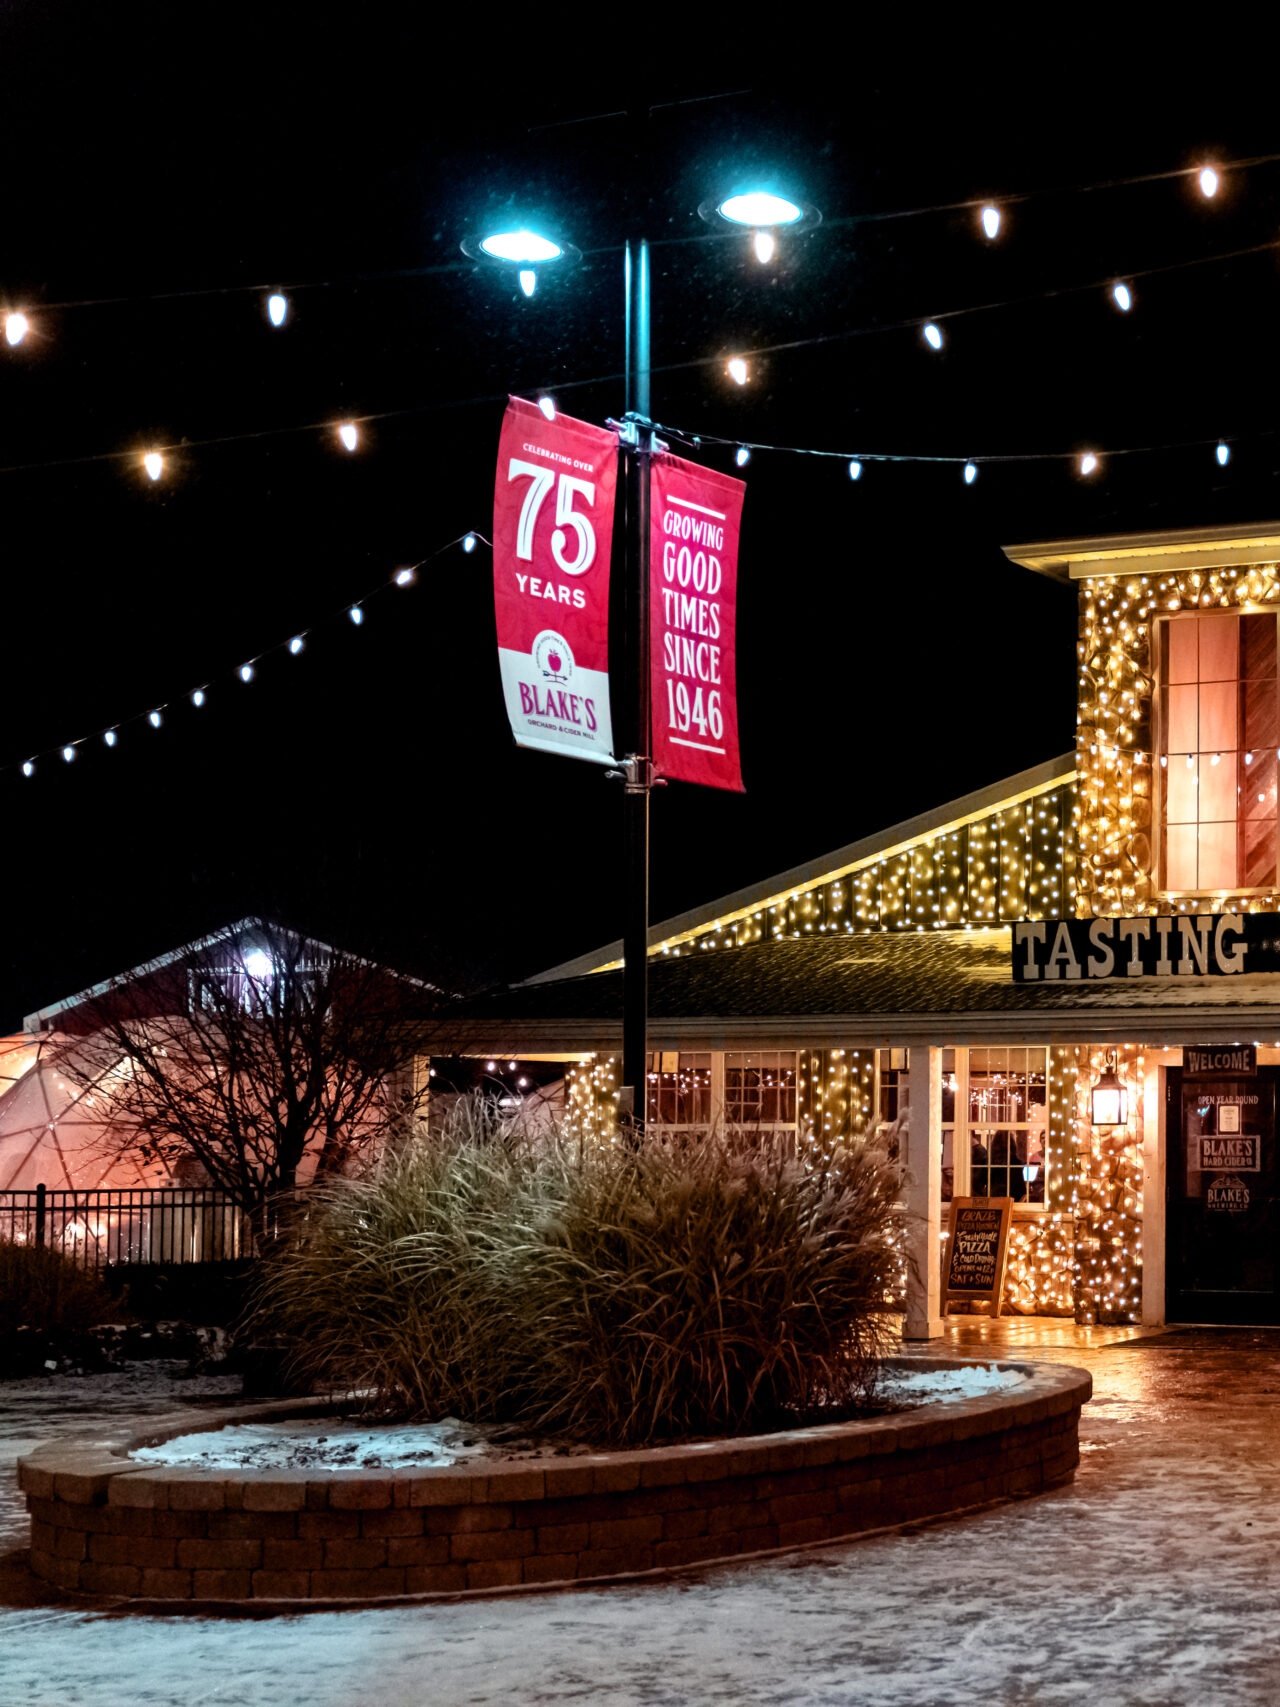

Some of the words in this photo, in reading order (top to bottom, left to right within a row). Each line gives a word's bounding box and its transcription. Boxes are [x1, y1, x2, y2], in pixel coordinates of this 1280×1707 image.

[523, 443, 572, 466] CELEBRATING
[573, 459, 594, 473] OVER
[508, 458, 596, 576] 75
[663, 510, 723, 551] GROWING
[663, 541, 722, 595] GOOD
[515, 572, 586, 609] YEARS
[662, 587, 721, 640] TIMES
[663, 631, 721, 685] SINCE
[518, 681, 597, 732] BLAKE'S
[527, 719, 558, 731] ORCHARD
[667, 678, 723, 741] 1946
[1015, 913, 1249, 980] TASTING
[1188, 1049, 1250, 1073] WELCOME
[1198, 1096, 1215, 1105] OPEN
[1216, 1096, 1234, 1105] YEAR
[1235, 1096, 1259, 1105] ROUND
[1203, 1140, 1253, 1157] BLAKE'S
[1203, 1157, 1223, 1167] HARD
[1224, 1156, 1246, 1167] CIDER
[1207, 1188, 1250, 1204] BLAKE'S
[958, 1241, 992, 1254] PIZZA
